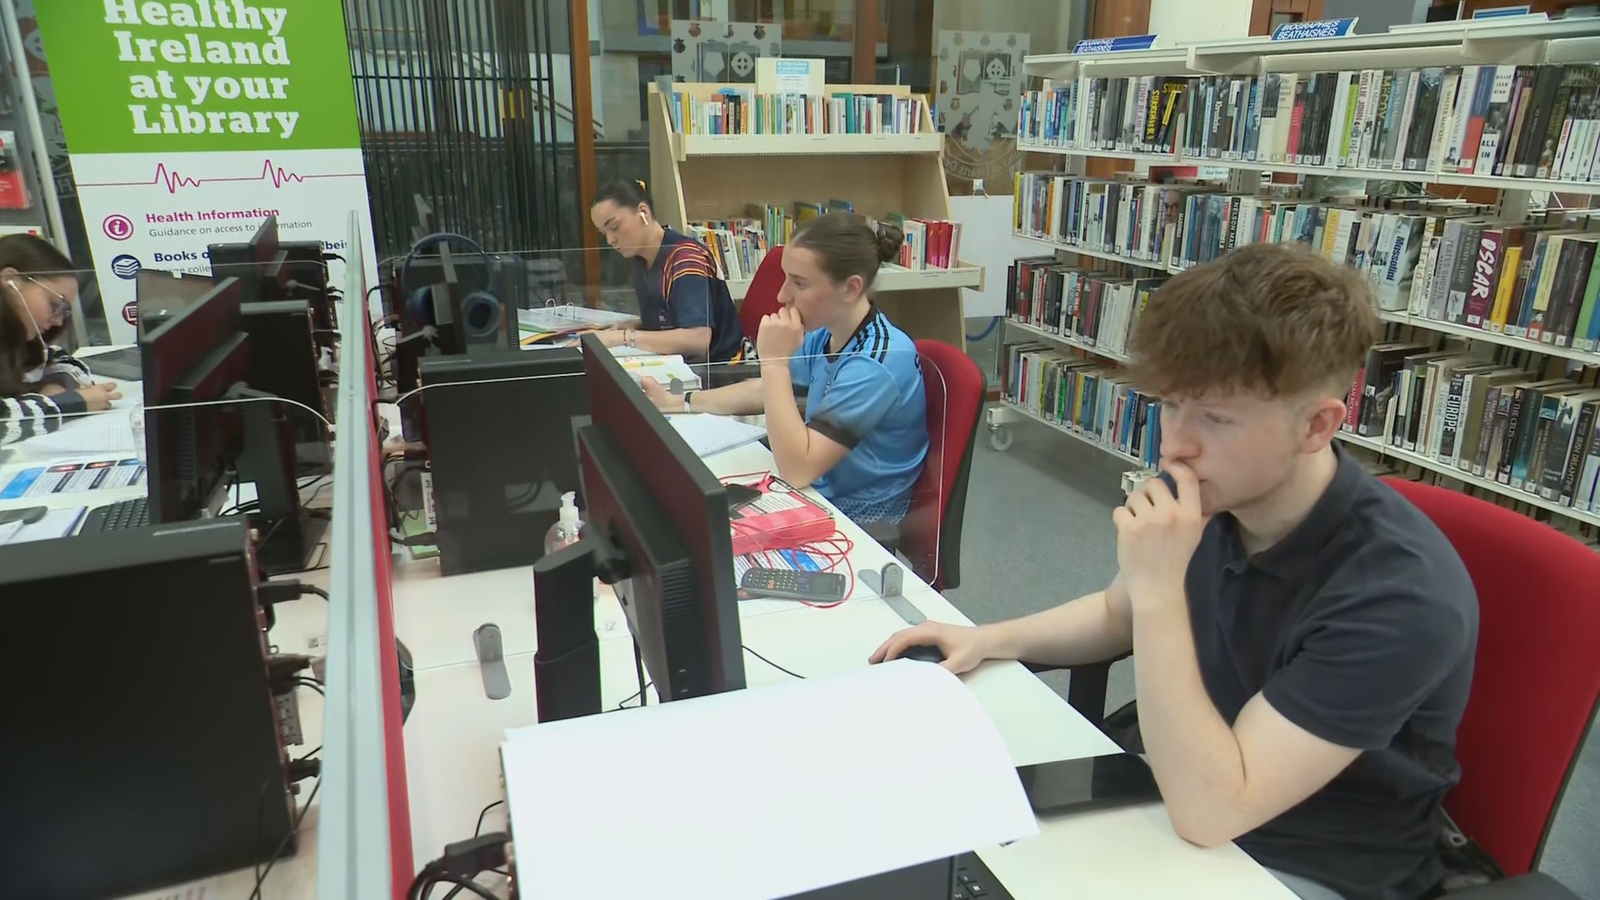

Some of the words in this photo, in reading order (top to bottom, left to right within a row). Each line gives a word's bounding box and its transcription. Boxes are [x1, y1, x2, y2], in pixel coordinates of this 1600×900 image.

[104, 0, 287, 35] Healthy
[113, 31, 290, 65] Ireland
[129, 70, 176, 99] at
[183, 75, 289, 105] your
[1137, 83, 1147, 104] TONY
[1358, 71, 1369, 98] WILLIE
[128, 104, 299, 138] Library
[1355, 99, 1365, 121] JOHN
[146, 212, 193, 224] Health
[198, 207, 280, 221] Information
[149, 227, 196, 238] Guidance
[215, 225, 243, 233] access
[245, 223, 256, 232] to
[258, 220, 313, 231] irmation
[1229, 202, 1239, 231] NELSON
[154, 250, 197, 262] Books
[1386, 236, 1405, 281] Mussolini
[1471, 238, 1497, 299] OSCAR
[1444, 394, 1461, 433] EUROPE
[1512, 403, 1521, 417] THE
[1508, 417, 1518, 438] CELTS
[1574, 436, 1584, 453] IRISH
